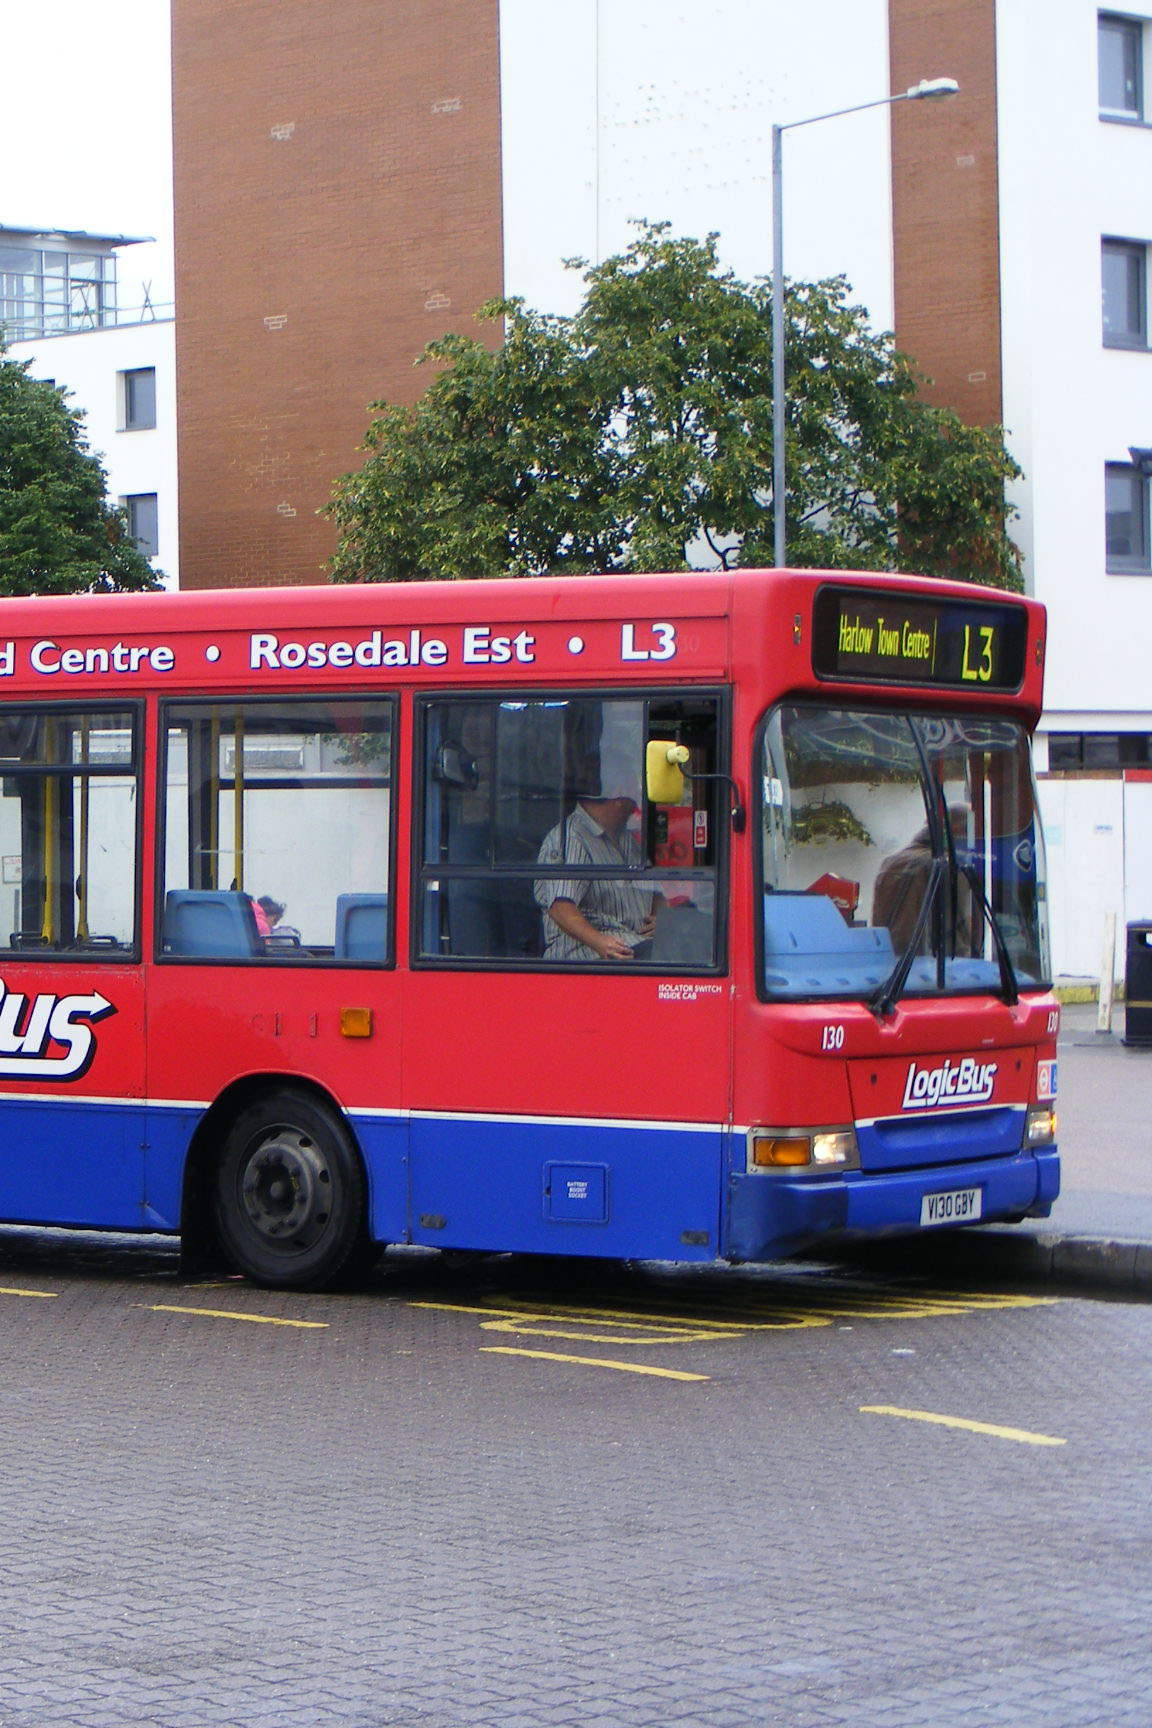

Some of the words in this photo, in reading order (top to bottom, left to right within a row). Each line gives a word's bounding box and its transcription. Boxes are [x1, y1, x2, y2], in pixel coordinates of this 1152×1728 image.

[30, 640, 175, 674] Centre
[250, 630, 448, 668] Rosedale
[463, 627, 536, 663] Est
[621, 623, 676, 661] L3
[839, 614, 873, 654] Harlow
[878, 617, 899, 656] Town
[902, 620, 930, 659] Centre
[962, 625, 994, 681] L3
[658, 984, 693, 992] ISOLATOR
[695, 985, 722, 993] SWITCH
[658, 992, 680, 1000] INSIDE
[682, 992, 697, 1000] CAB
[822, 1025, 844, 1050] 130
[902, 1058, 997, 1109] LogicBus
[928, 1196, 953, 1220] V130
[955, 1192, 975, 1216] GBY
